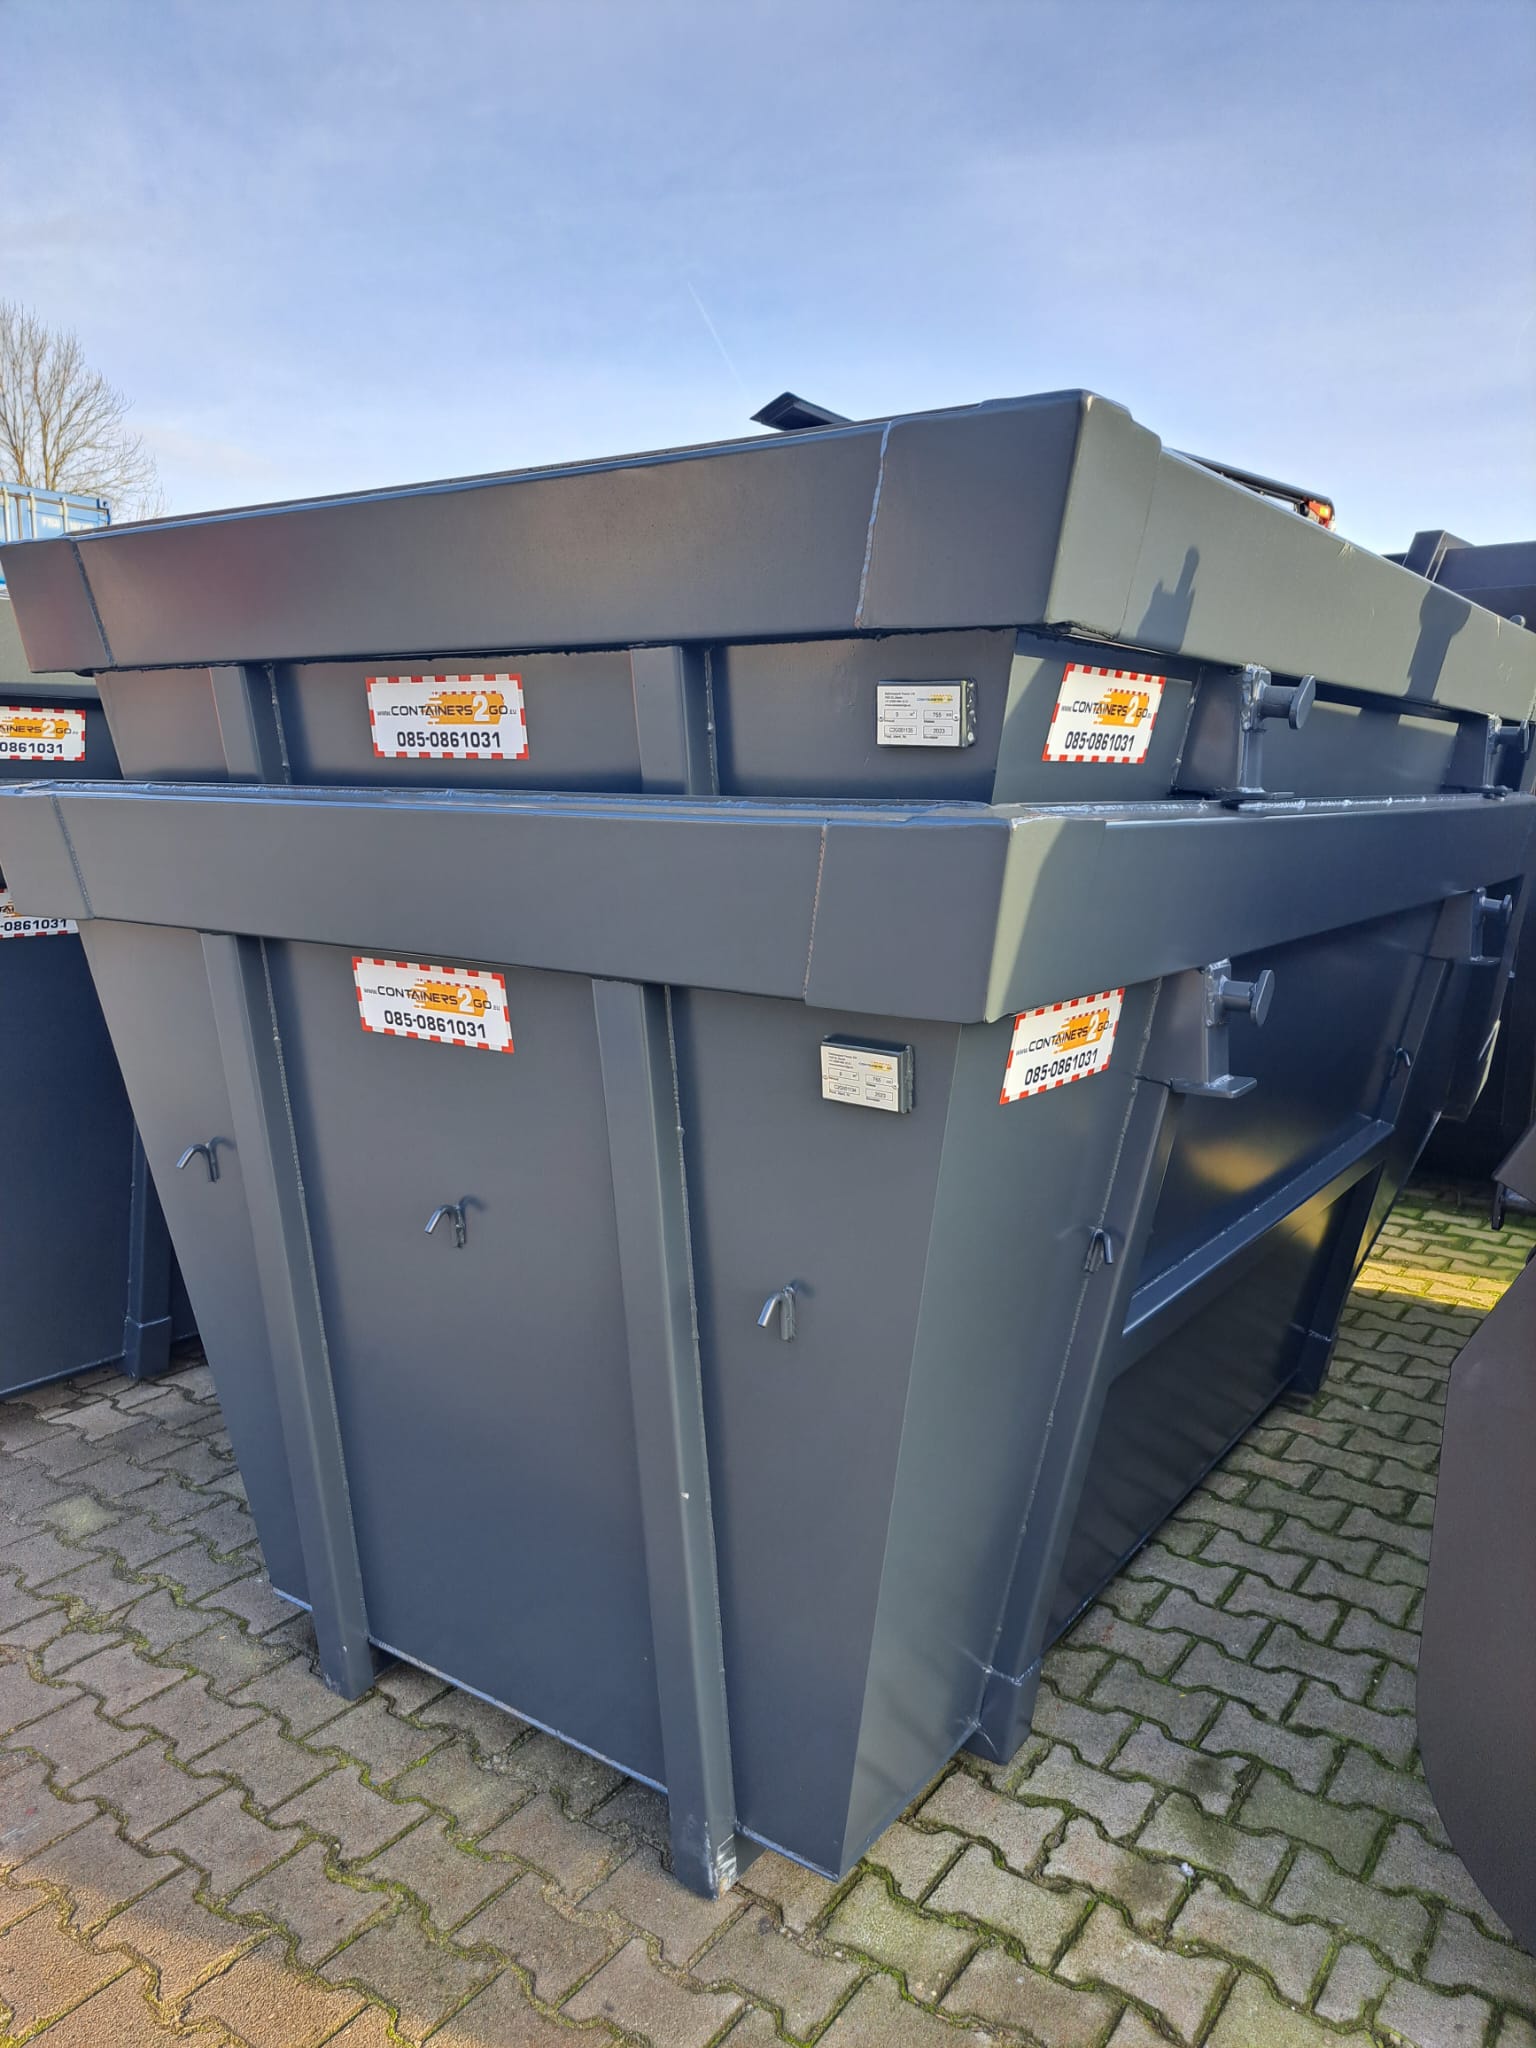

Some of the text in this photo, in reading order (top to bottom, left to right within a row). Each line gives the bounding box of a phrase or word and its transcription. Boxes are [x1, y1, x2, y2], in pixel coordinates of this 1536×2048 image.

[397, 731, 501, 748] 085-0861031
[1064, 731, 1135, 752] 085-0861031
[384, 1010, 486, 1039] 085-0861031
[1024, 1048, 1098, 1086] 085-0861031
